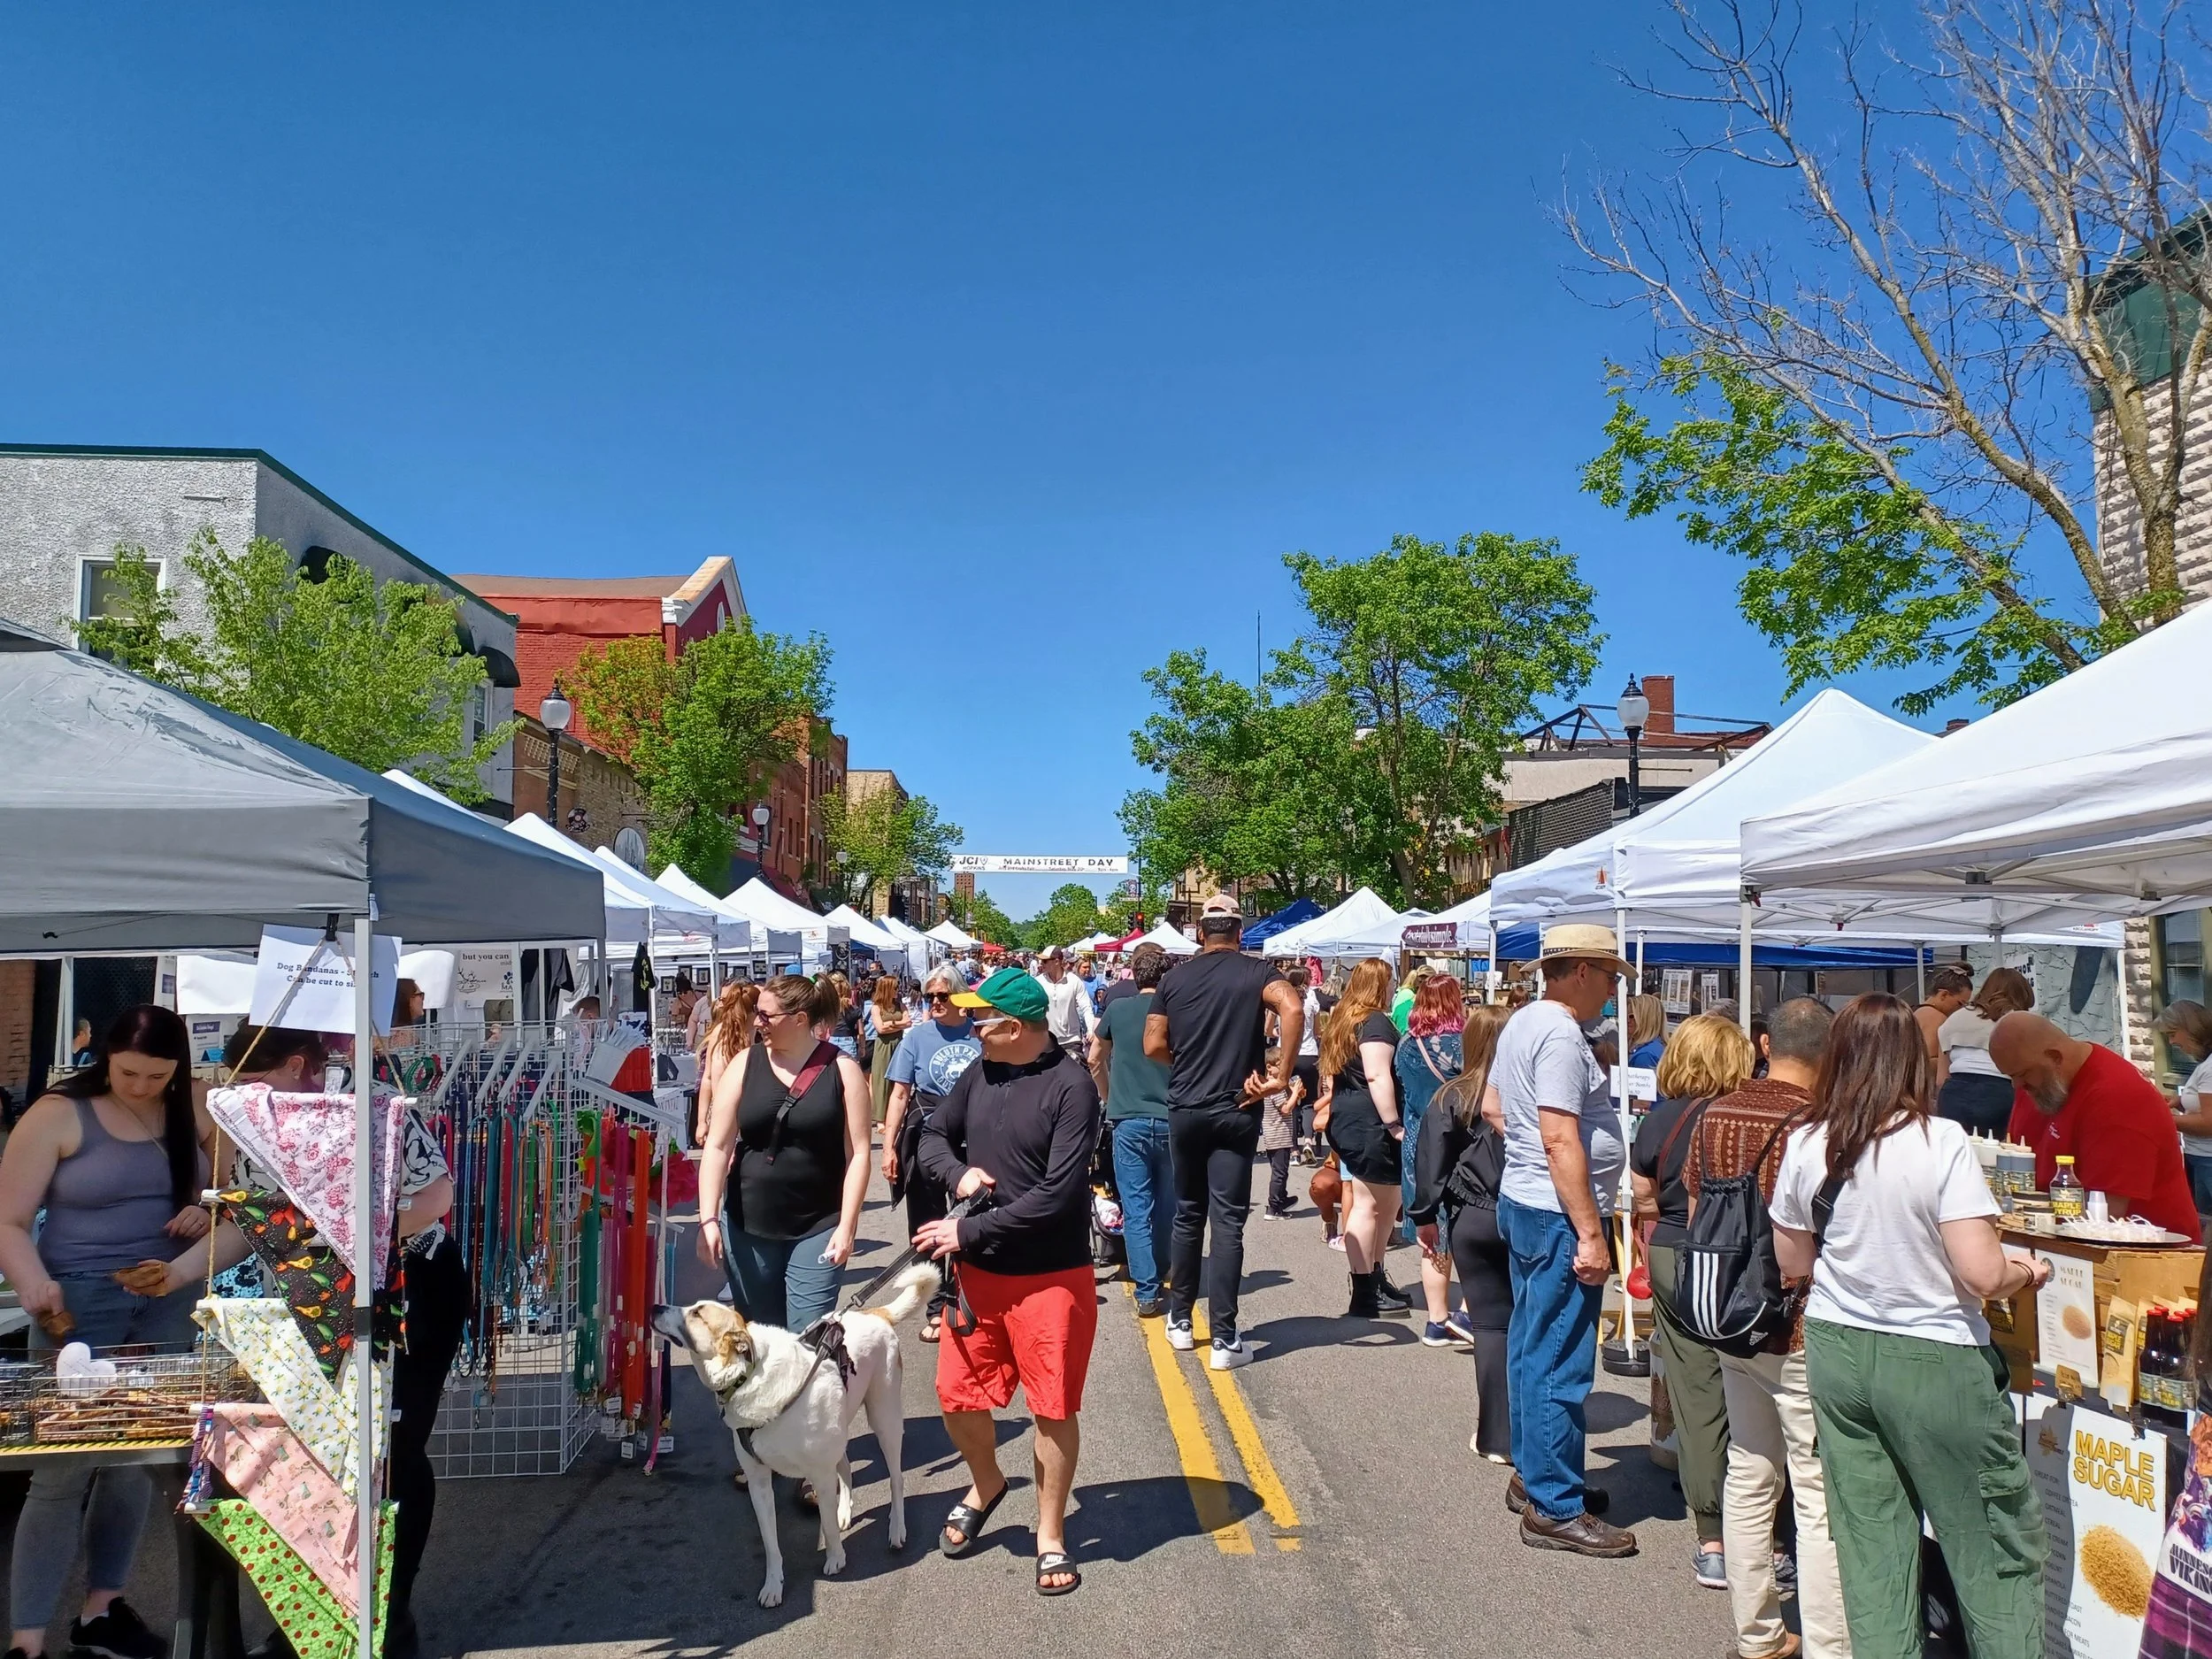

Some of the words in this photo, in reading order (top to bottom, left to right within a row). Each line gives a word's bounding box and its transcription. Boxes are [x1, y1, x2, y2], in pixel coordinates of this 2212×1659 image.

[959, 856, 979, 865] JCI
[1003, 857, 1079, 866] MAINSTREET
[277, 962, 294, 972] Dog
[305, 976, 317, 985] be
[933, 1046, 960, 1065] DULUTH
[963, 1047, 979, 1062] PAC
[2075, 1429, 2154, 1483] MAPLE
[2073, 1456, 2156, 1512] SUGAR
[2170, 1543, 2212, 1578] MINNES
[2170, 1554, 2212, 1595] VIKIN
[2074, 1633, 2090, 1647] MEATS
